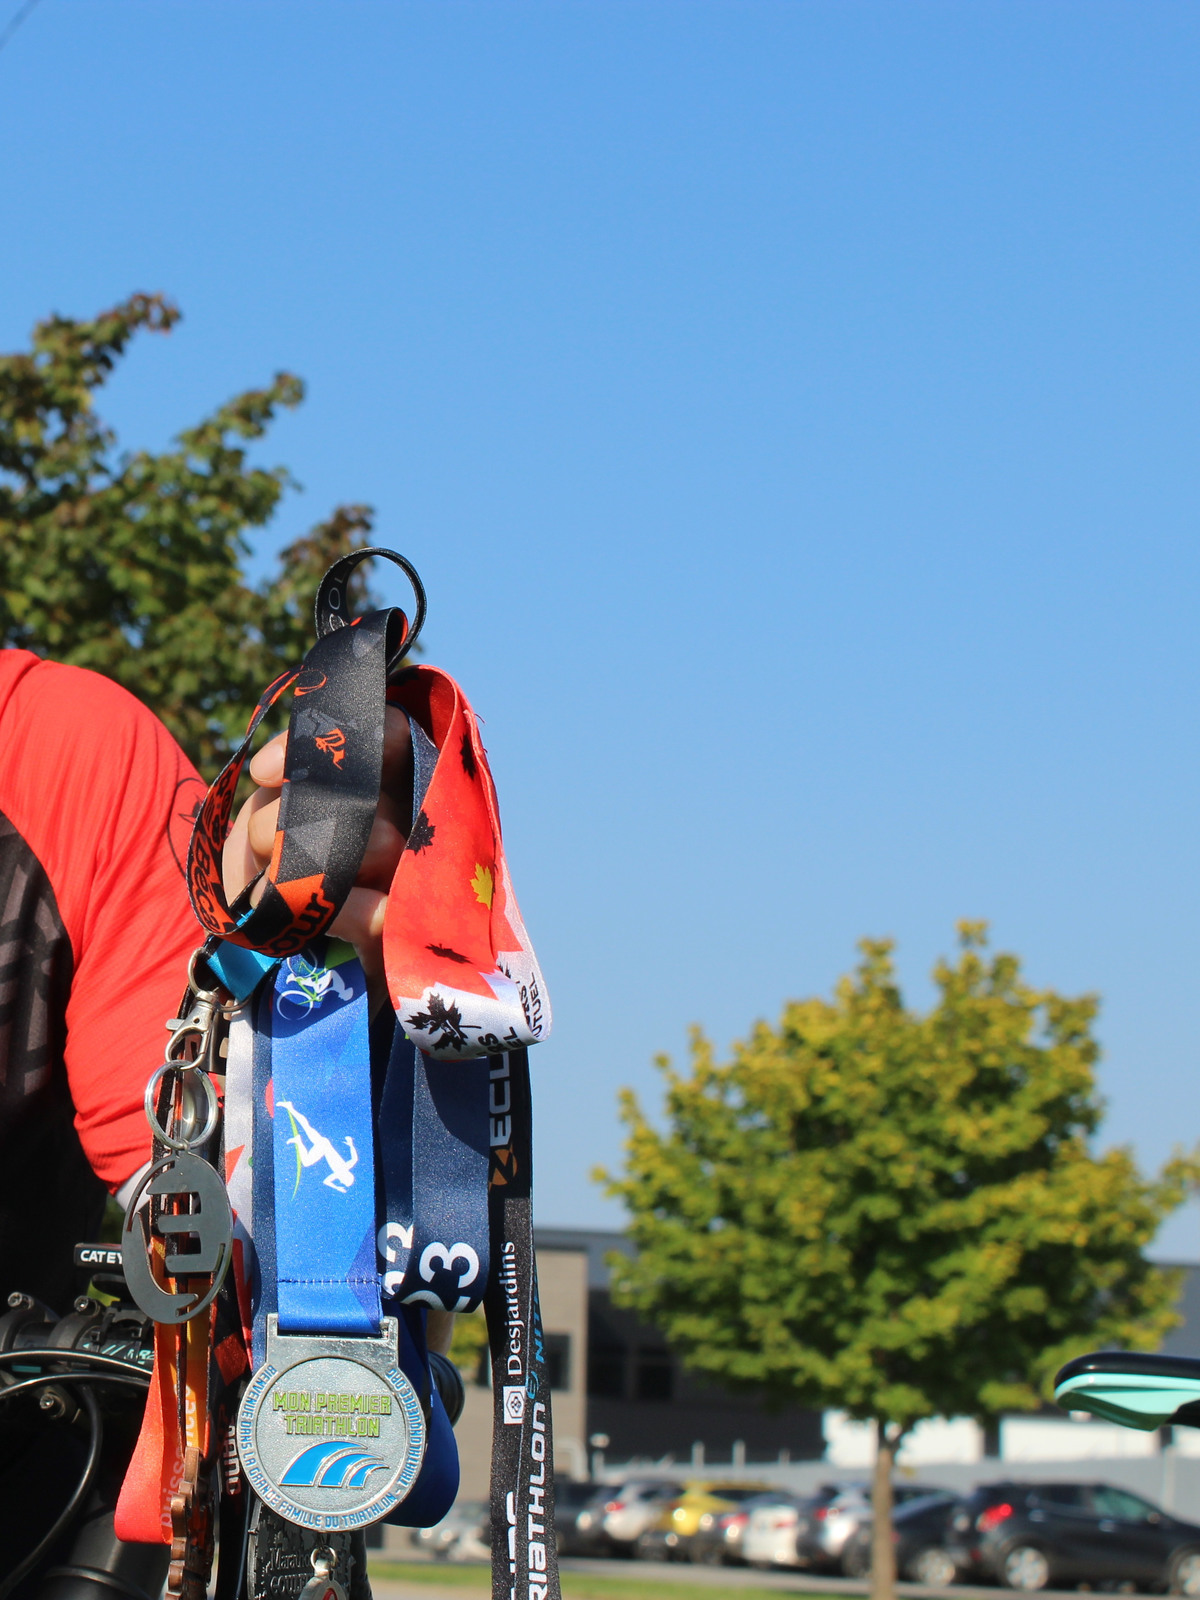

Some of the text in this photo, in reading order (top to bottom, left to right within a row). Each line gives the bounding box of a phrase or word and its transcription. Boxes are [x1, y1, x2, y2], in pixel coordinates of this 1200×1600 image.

[80, 1249, 123, 1265] CATEY
[498, 1241, 525, 1376] Desjardins
[242, 1365, 279, 1415] BIENVENUE
[273, 1391, 392, 1415] MON PREMIER
[238, 1416, 253, 1450] DANS
[284, 1415, 380, 1437] TRIATHLON
[243, 1452, 256, 1466] LA
[248, 1468, 281, 1506] GRANDE
[528, 1401, 548, 1600] RIATHLON
[279, 1502, 322, 1528] FAMILLE
[325, 1515, 340, 1528] DU
[343, 1493, 398, 1527] TRIATHLON
